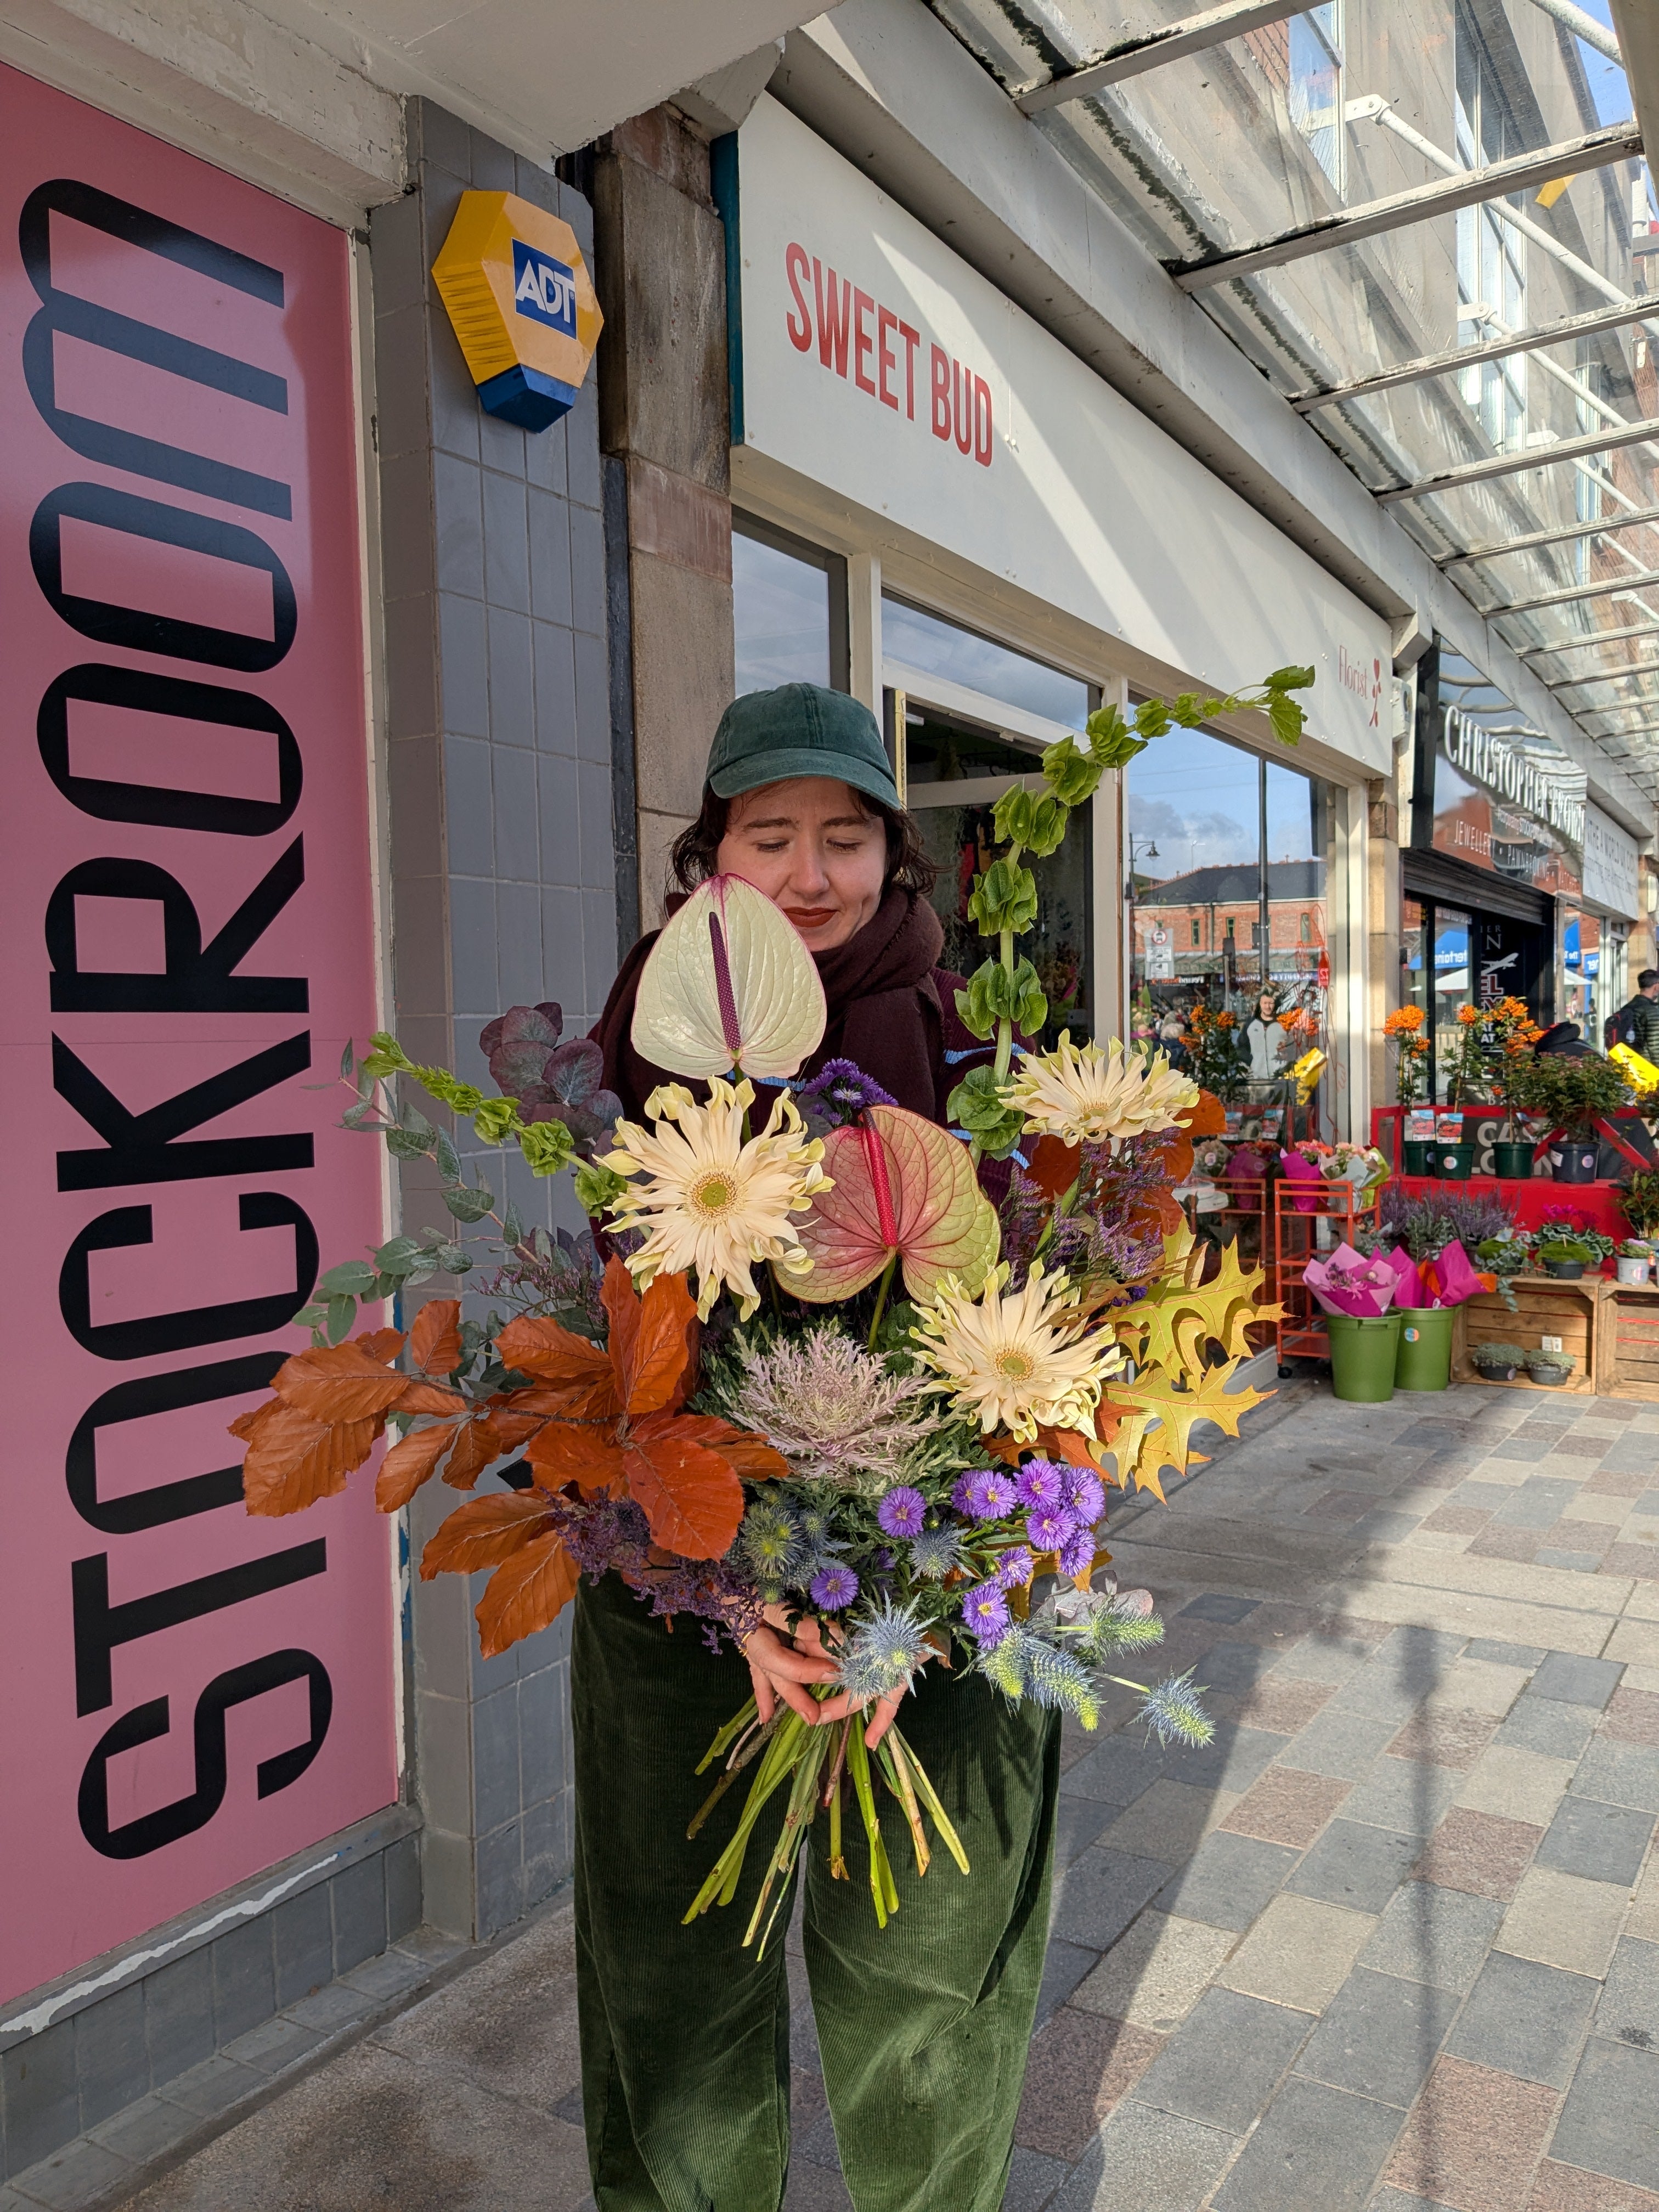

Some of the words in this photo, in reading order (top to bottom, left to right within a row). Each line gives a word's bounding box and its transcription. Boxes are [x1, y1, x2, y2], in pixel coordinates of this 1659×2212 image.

[515, 259, 575, 324] ADT
[786, 242, 919, 421] SWEET
[932, 342, 992, 467] BUD
[1339, 645, 1368, 699] Florist
[1444, 706, 1548, 821] CHRISTOPHER
[1551, 785, 1585, 846] BROWN
[1454, 820, 1495, 859] JEWELLERY
[19, 179, 332, 1860] STOCKROOM
